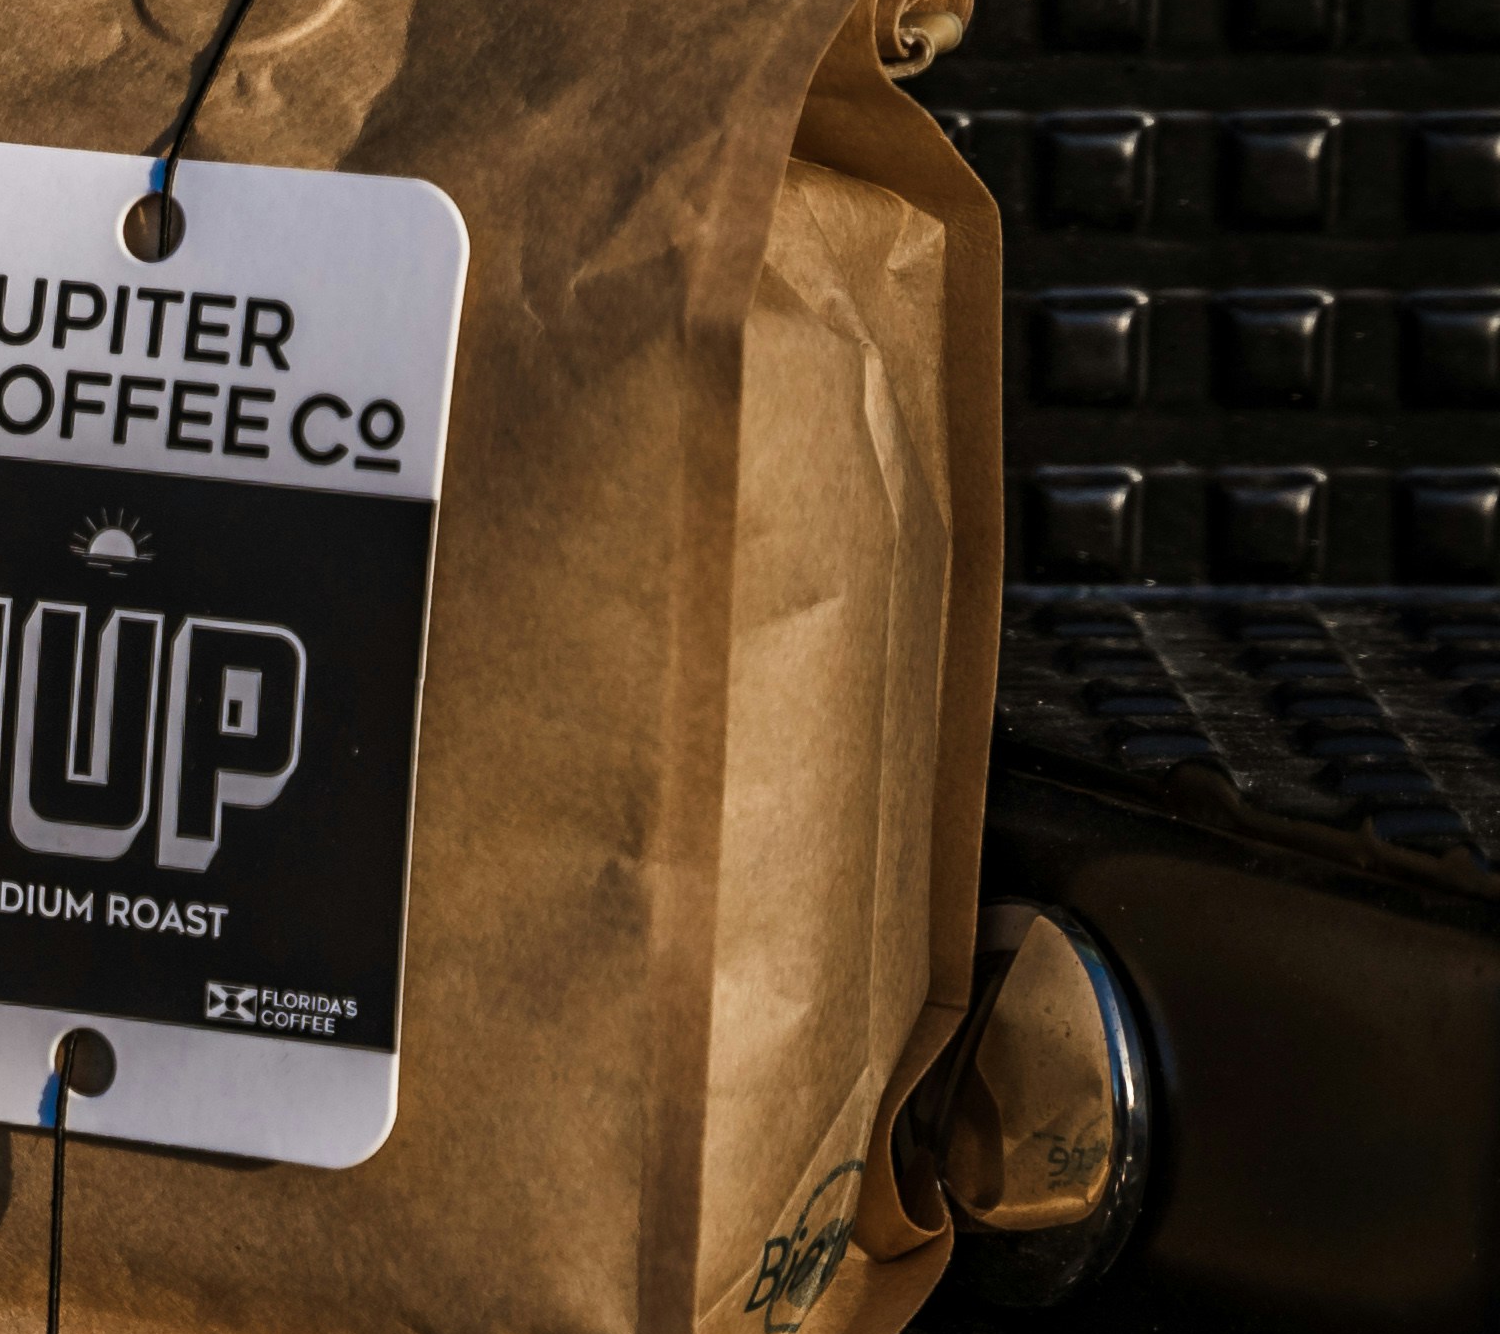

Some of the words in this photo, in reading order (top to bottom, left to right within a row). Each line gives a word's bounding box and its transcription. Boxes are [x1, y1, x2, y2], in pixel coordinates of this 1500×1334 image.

[108, 895, 228, 937] ROAST
[262, 990, 357, 1017] FLORIDA'S
[261, 1010, 335, 1033] COFFEE
